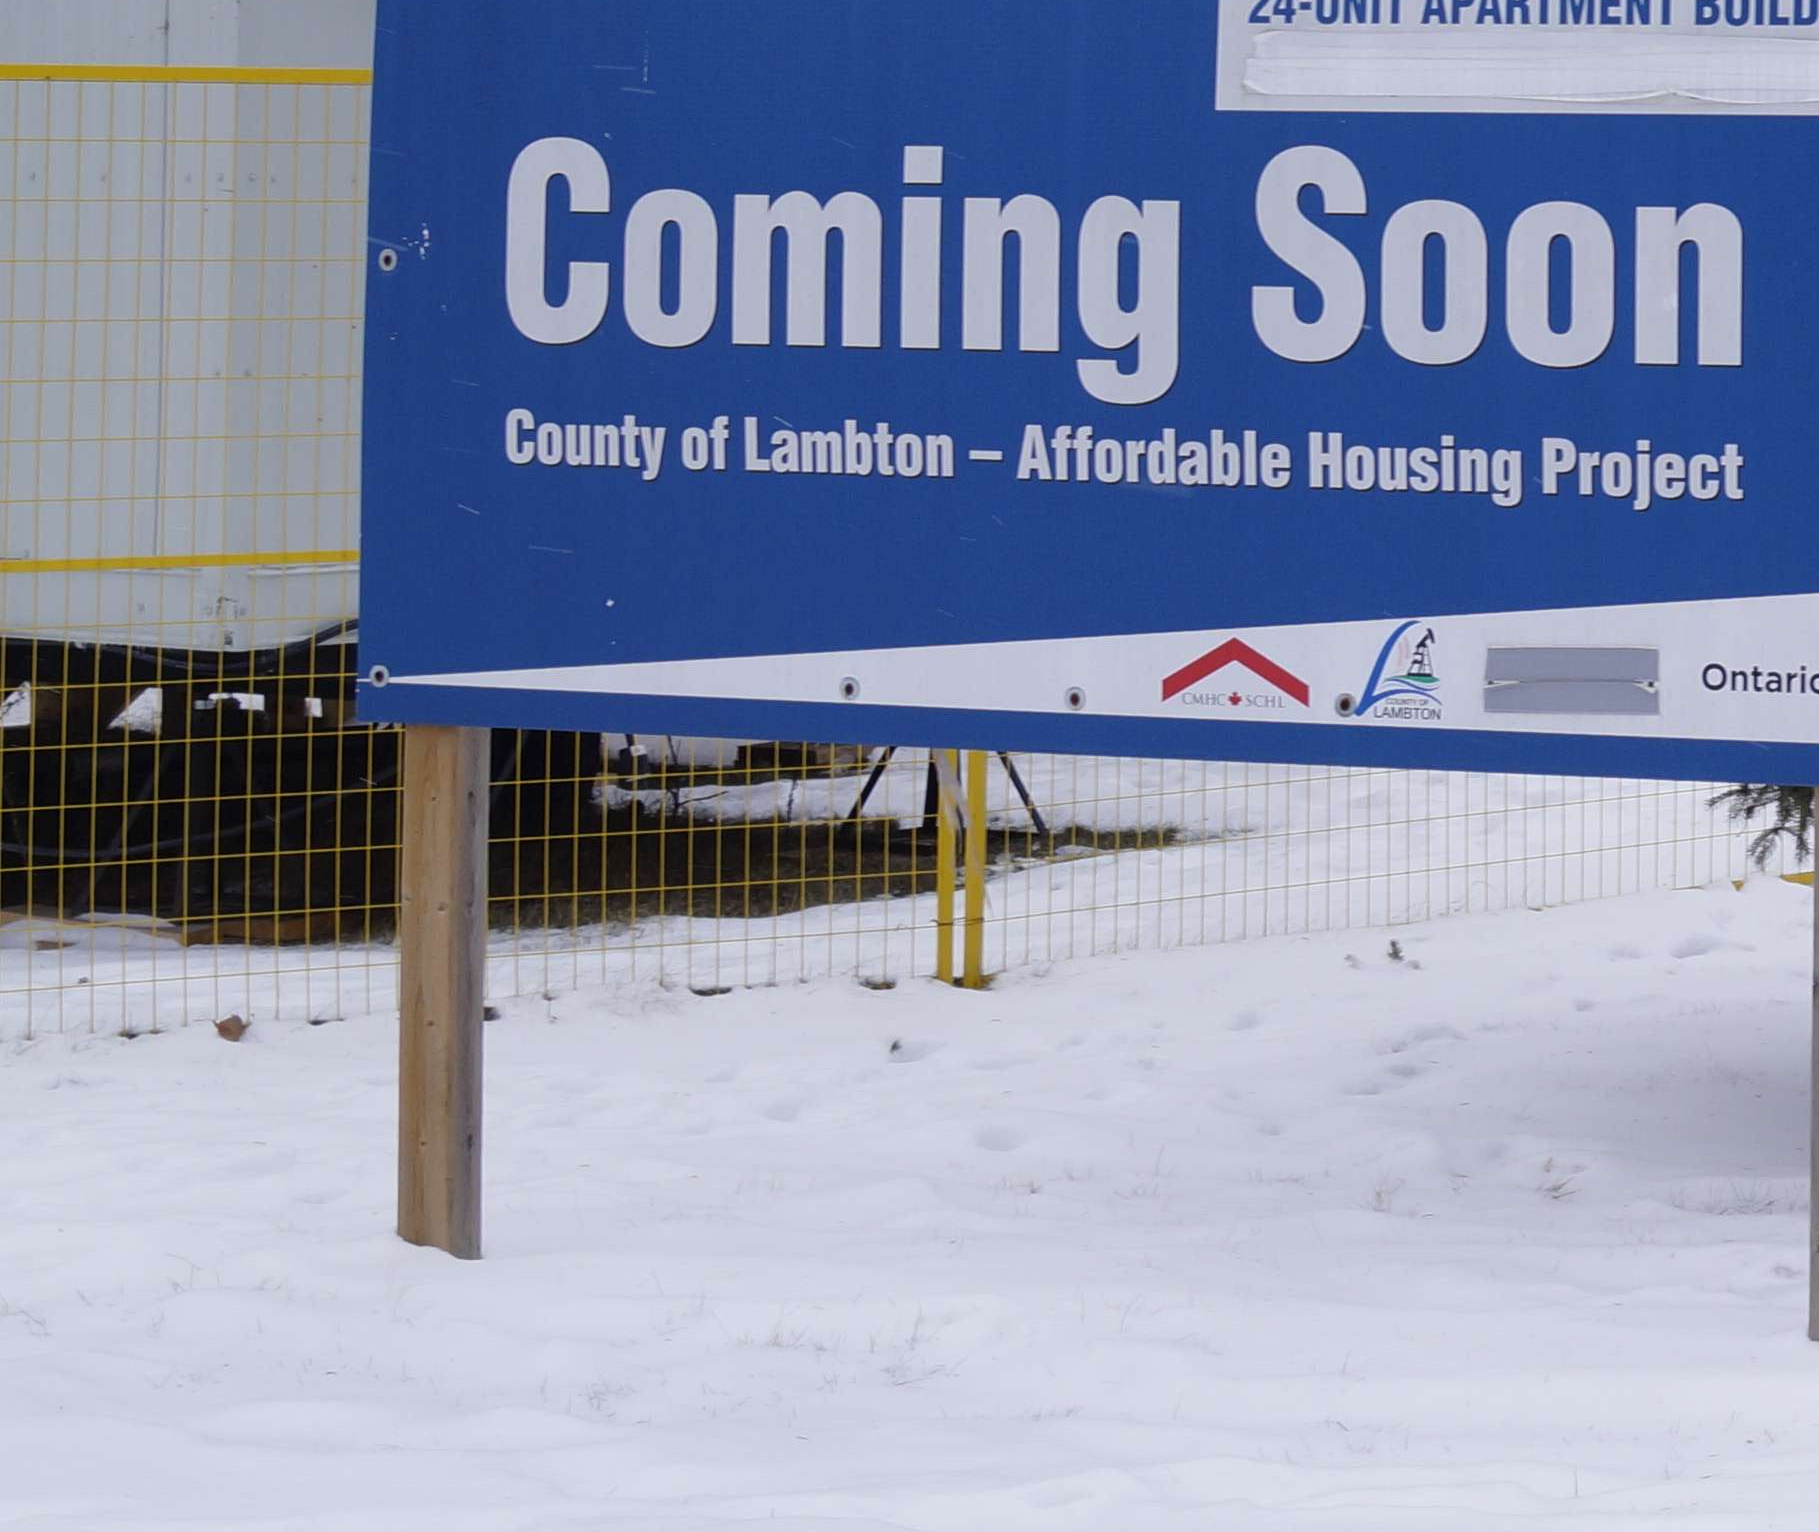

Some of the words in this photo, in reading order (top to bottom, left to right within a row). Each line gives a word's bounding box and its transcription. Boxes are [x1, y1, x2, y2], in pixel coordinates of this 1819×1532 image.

[505, 136, 1181, 406] Coming
[1251, 145, 1743, 368] Soon
[505, 408, 666, 481] County
[681, 415, 729, 470] of
[744, 416, 955, 477] Lambton
[1017, 424, 1291, 488] Affordable
[1308, 431, 1522, 507] Housing
[1542, 437, 1744, 511] Project
[1181, 692, 1226, 706] CMHC
[1245, 694, 1285, 709] SCHL
[1373, 706, 1442, 720] LAMBTON
